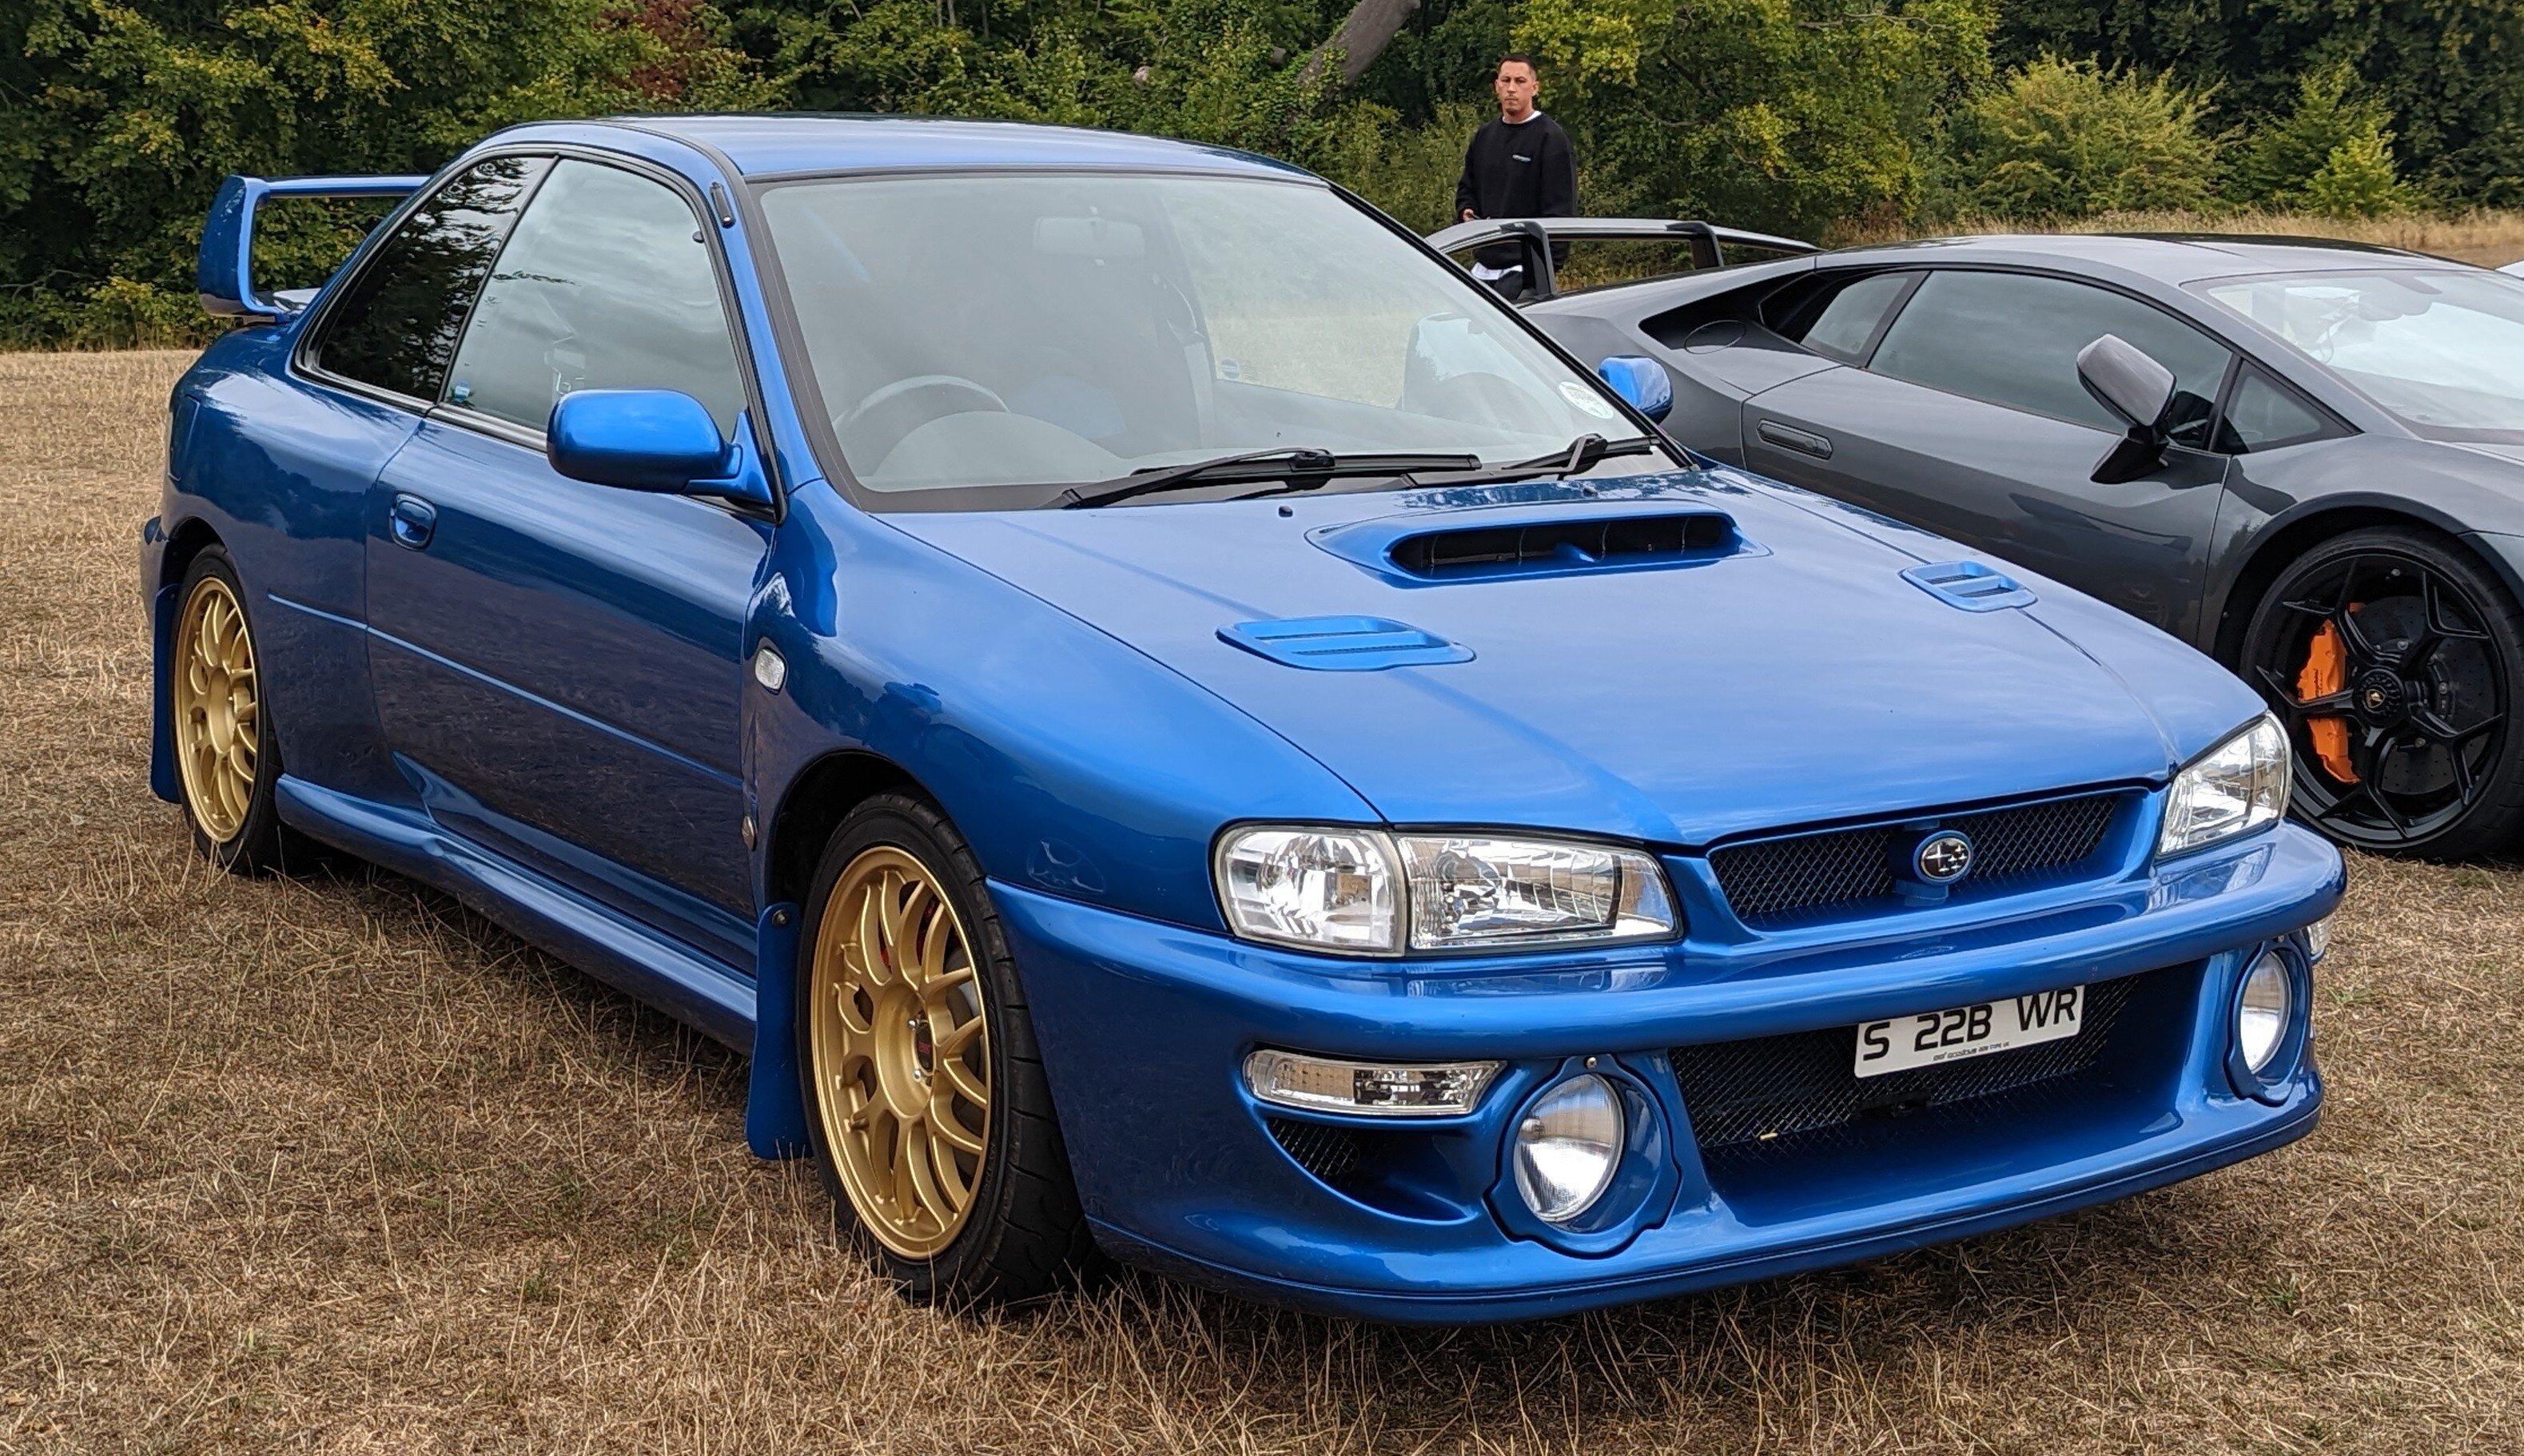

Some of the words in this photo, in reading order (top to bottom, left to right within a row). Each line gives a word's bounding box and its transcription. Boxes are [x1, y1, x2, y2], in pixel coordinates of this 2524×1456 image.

[1863, 1020, 1891, 1061] S
[1914, 1004, 1993, 1052] 22B
[2016, 988, 2077, 1031] WR
